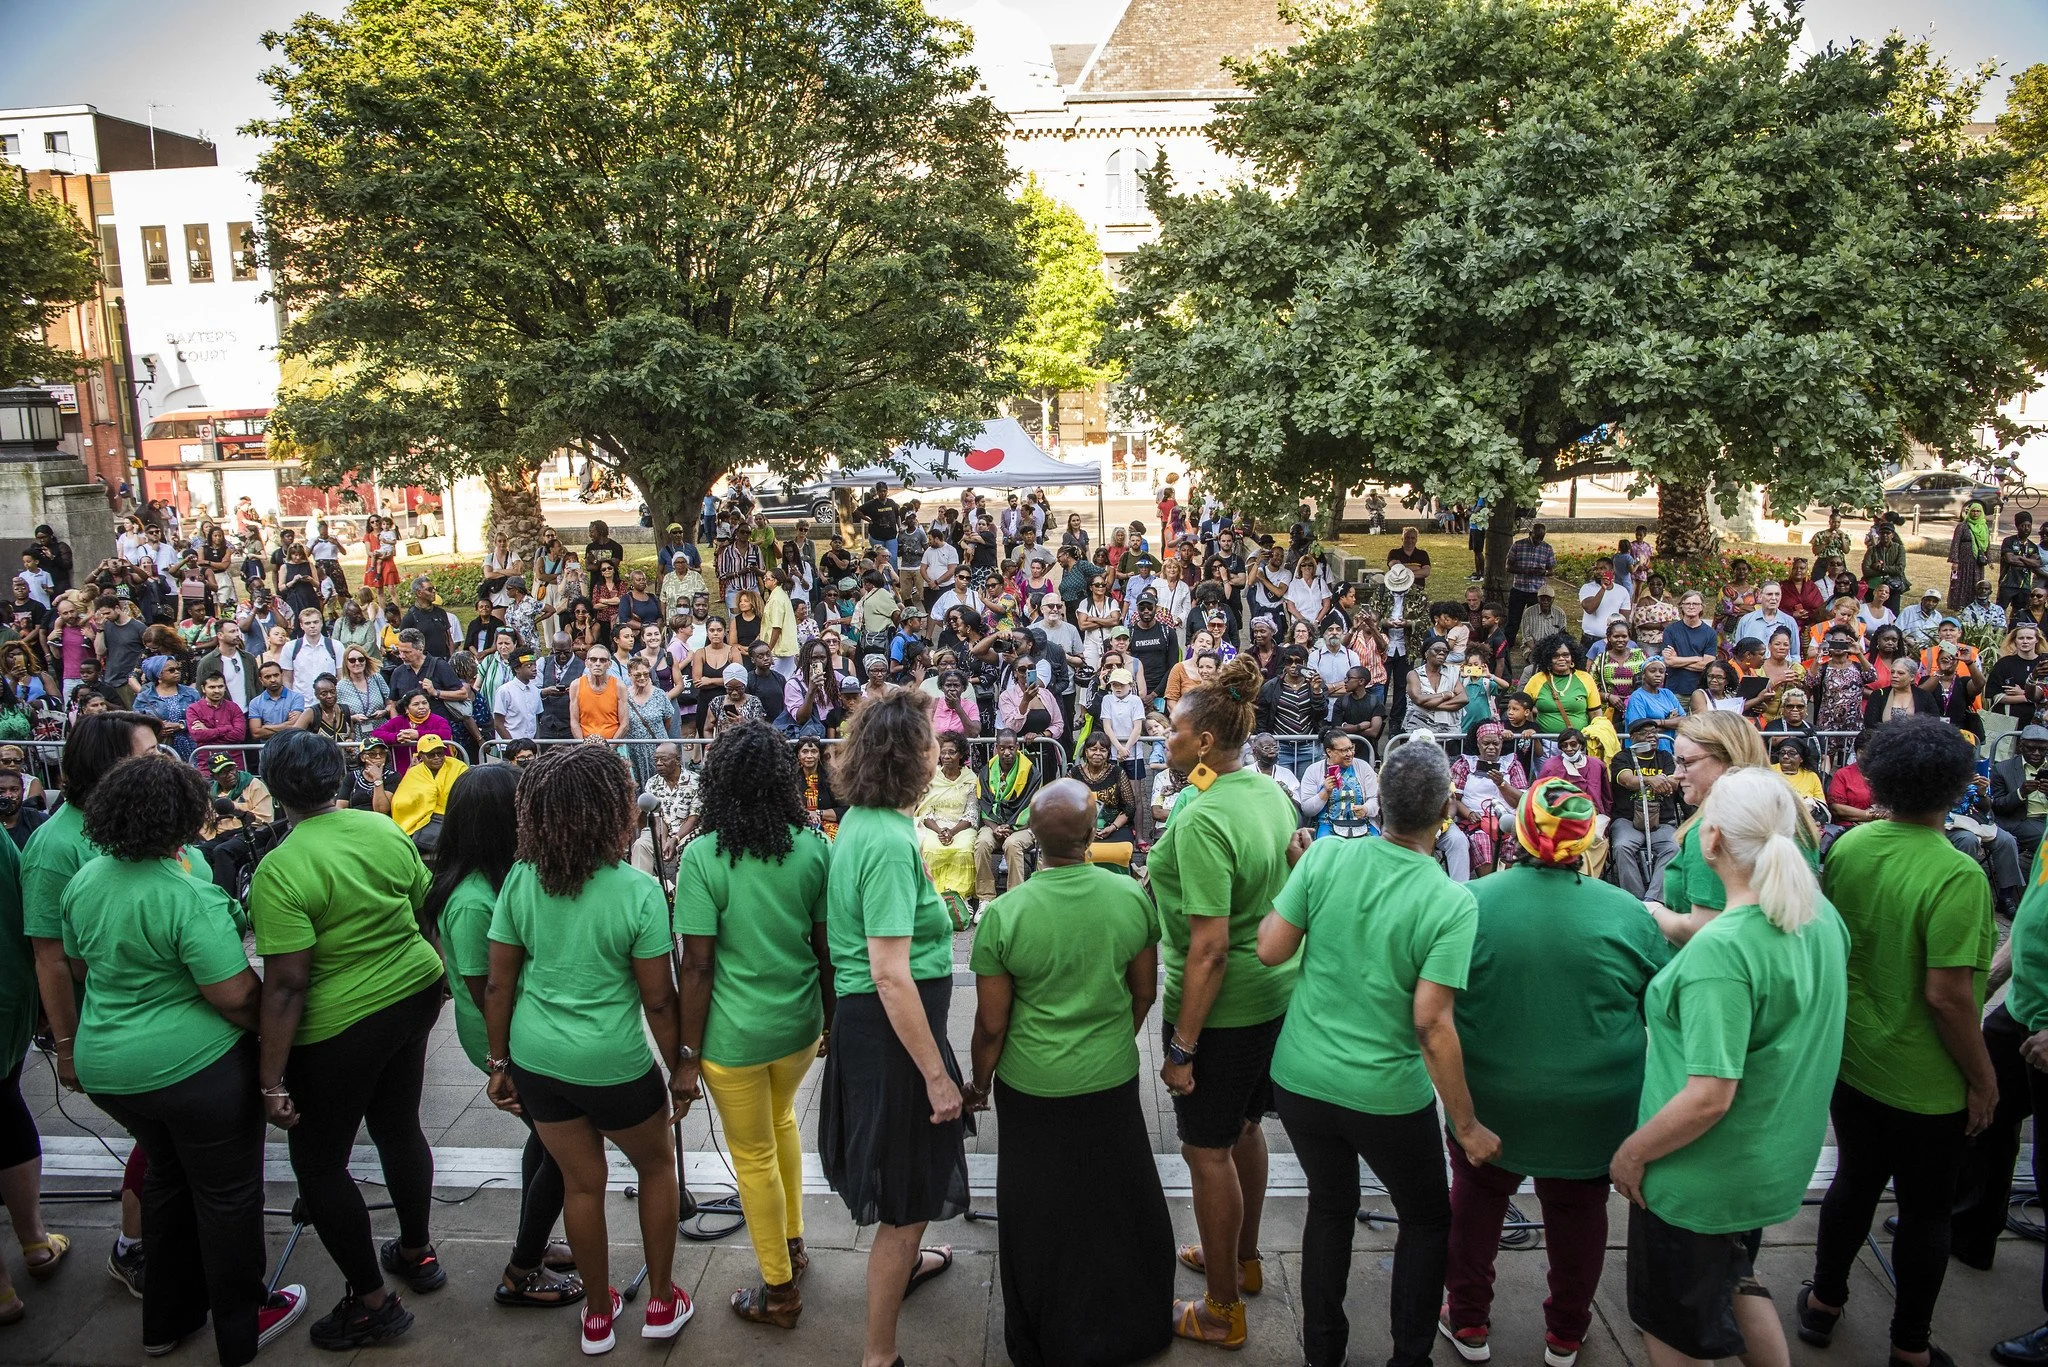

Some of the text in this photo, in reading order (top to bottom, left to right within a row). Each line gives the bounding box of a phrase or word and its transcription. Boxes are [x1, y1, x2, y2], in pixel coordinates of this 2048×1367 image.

[166, 330, 237, 345] BAXTER'S
[176, 348, 228, 362] COURT
[1135, 638, 1161, 646] GYMSHARK
[215, 754, 228, 763] JA
